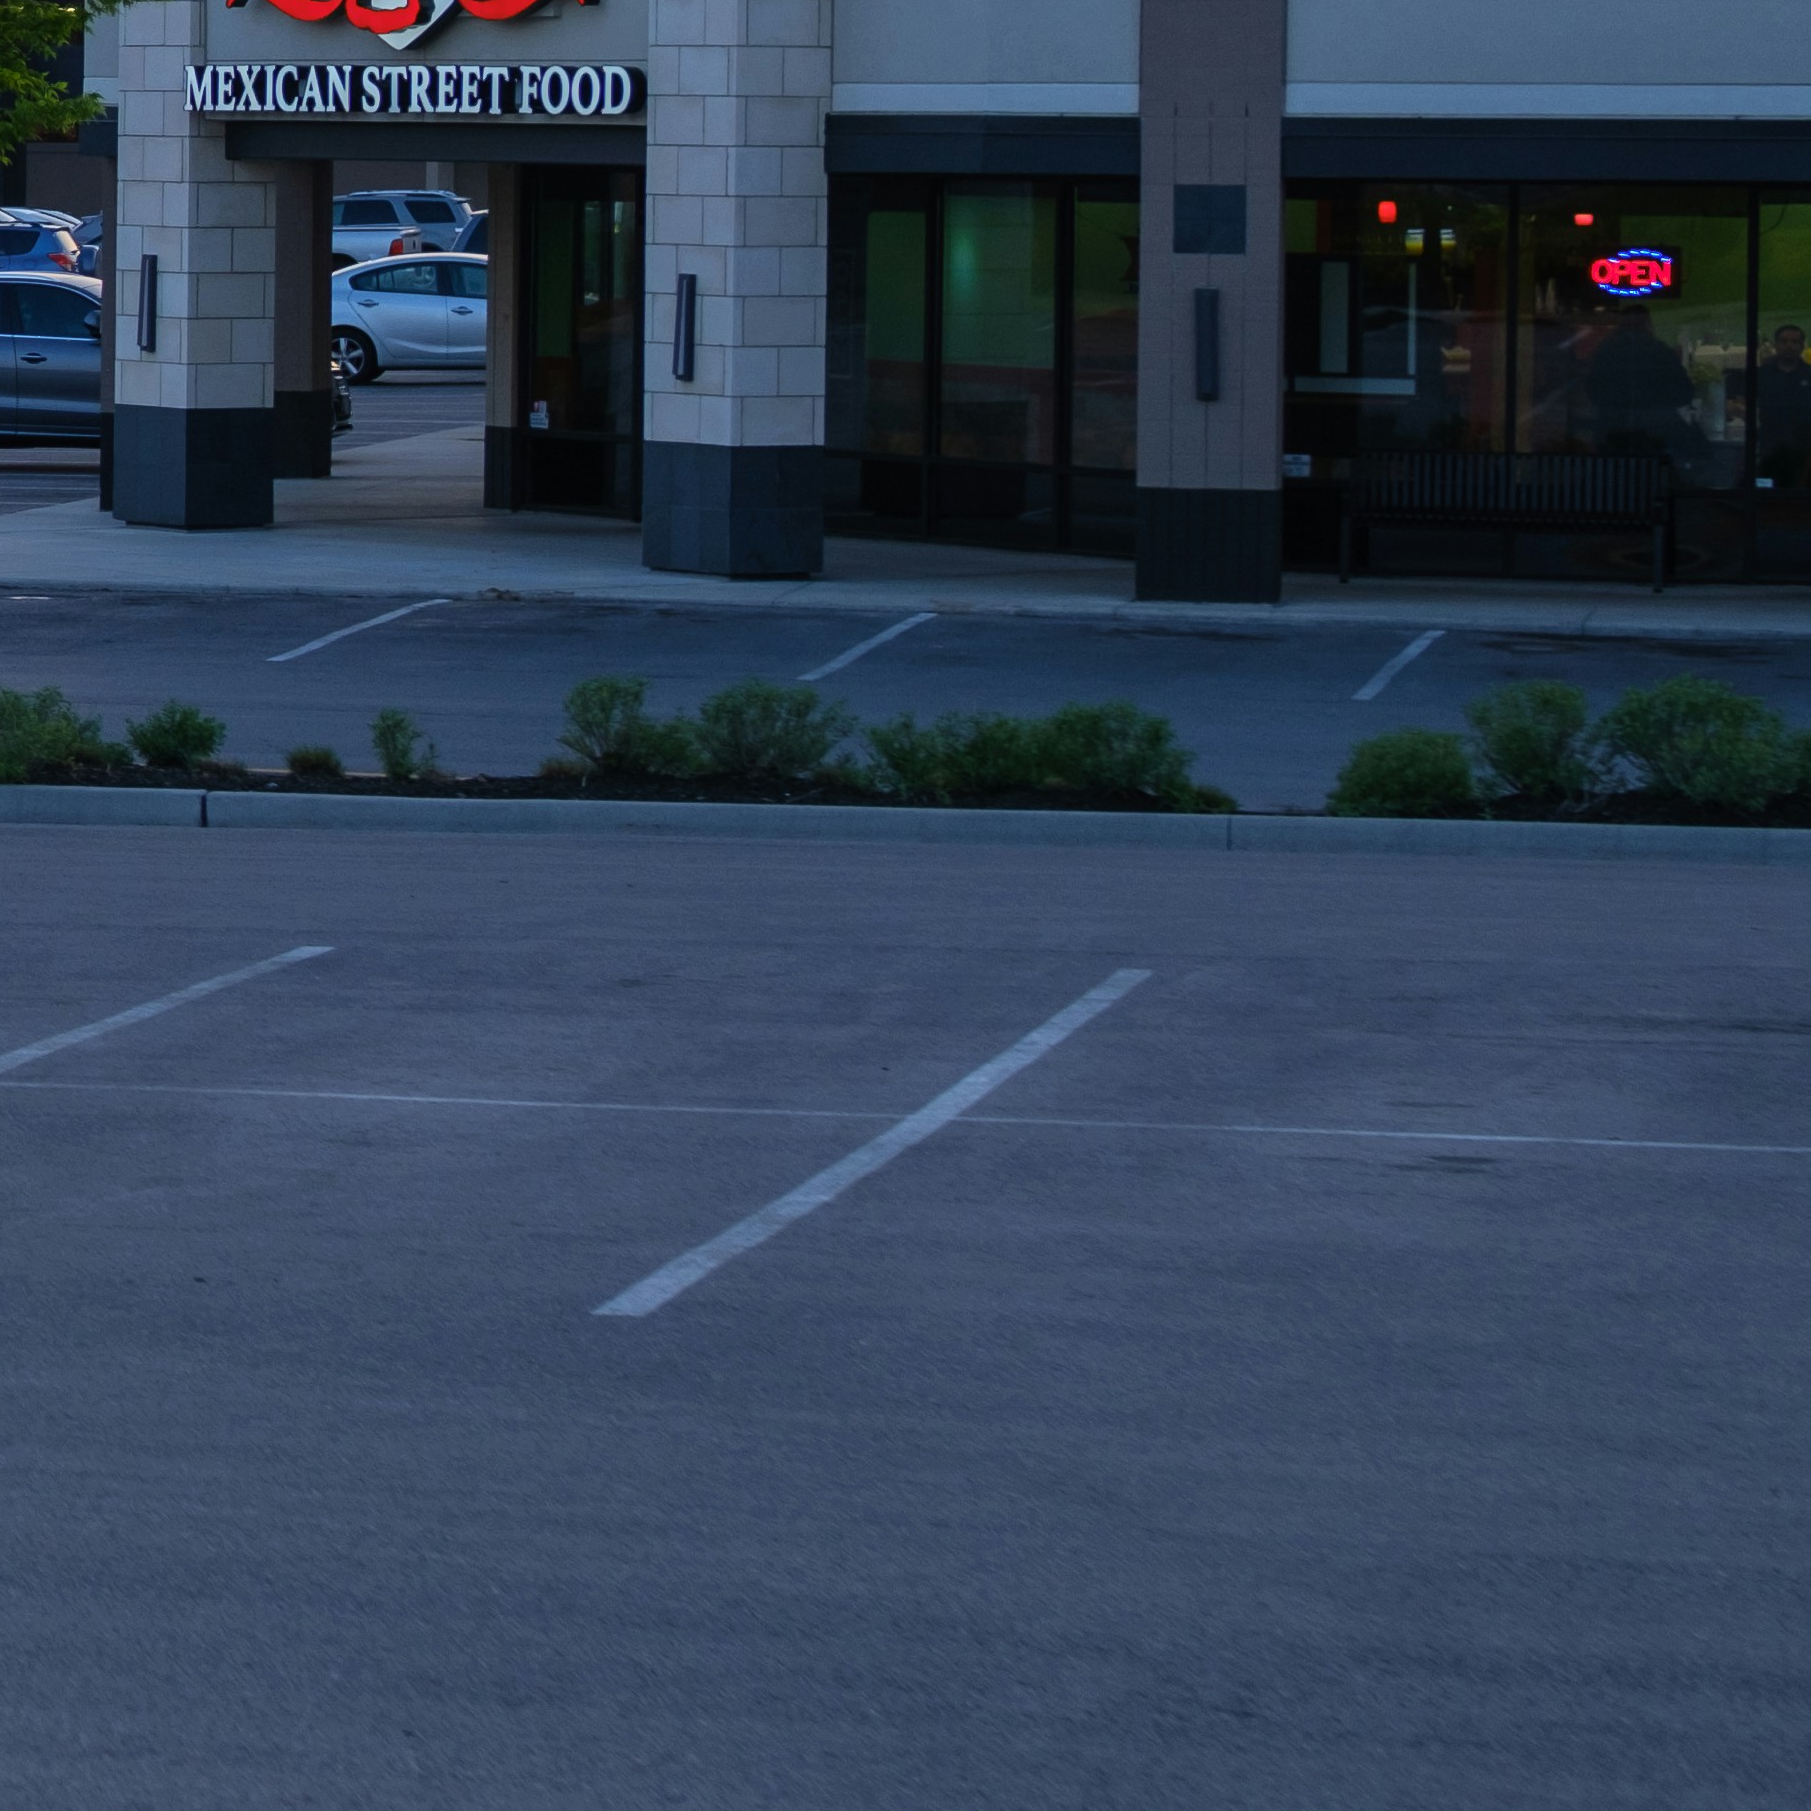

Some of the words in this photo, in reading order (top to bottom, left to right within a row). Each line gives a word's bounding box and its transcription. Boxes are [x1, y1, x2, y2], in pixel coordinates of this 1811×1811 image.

[183, 64, 353, 113] MEXICAN
[361, 64, 510, 115] STREET
[519, 64, 633, 116] FOOD
[1590, 258, 1672, 286] OPEN
